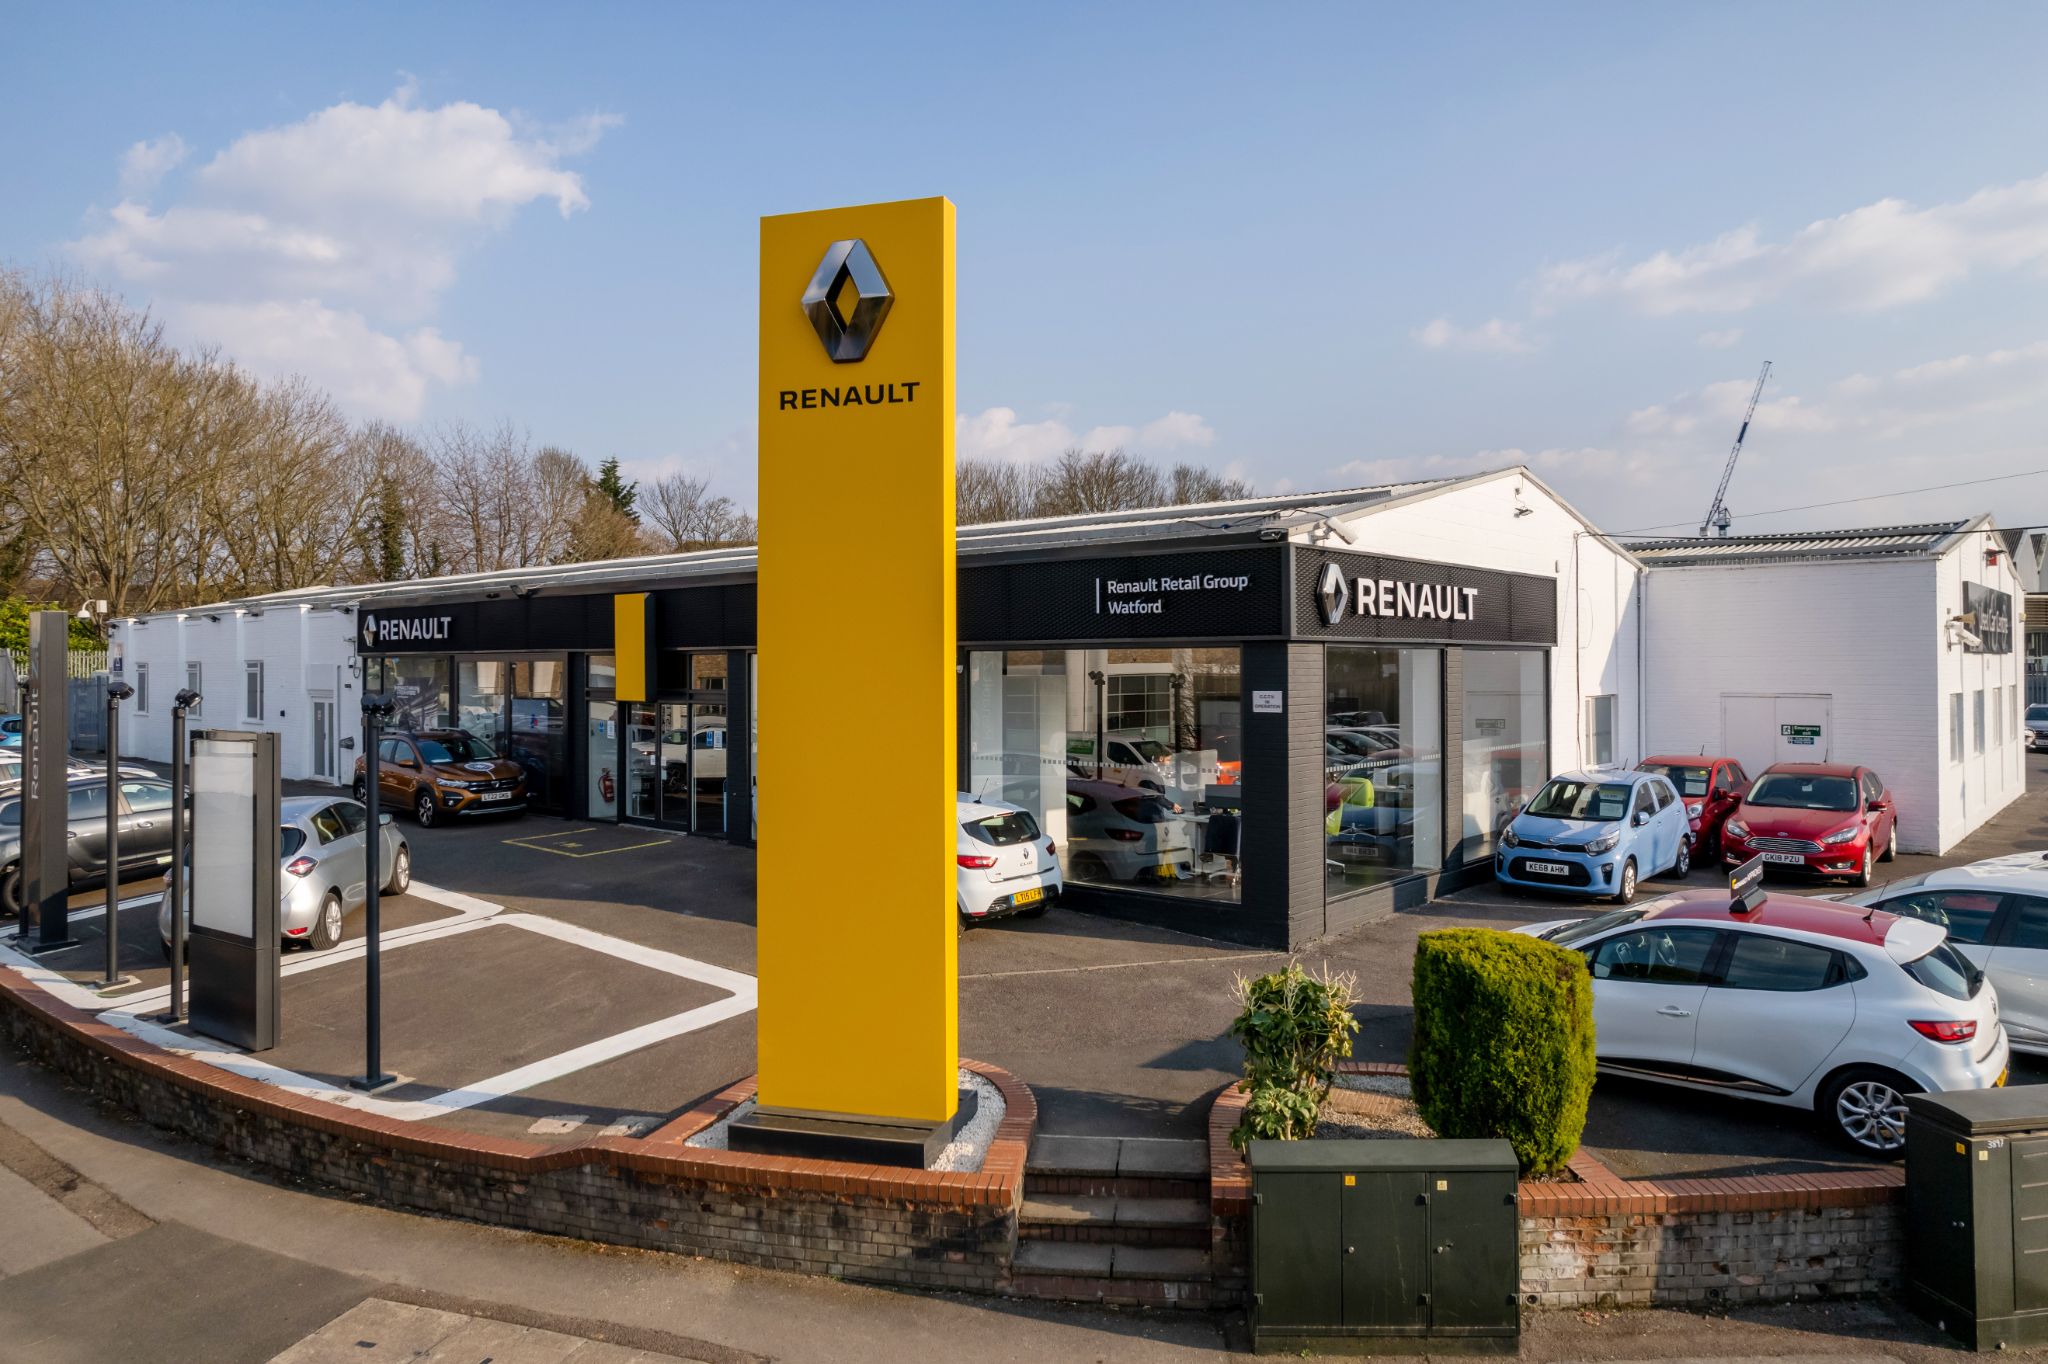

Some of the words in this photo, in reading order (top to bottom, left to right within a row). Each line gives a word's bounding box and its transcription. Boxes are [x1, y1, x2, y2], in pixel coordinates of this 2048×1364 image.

[780, 382, 920, 410] RENAULT
[1107, 577, 1158, 594] Renault
[1161, 575, 1200, 591] Retail
[1203, 574, 1249, 591] Group
[1108, 599, 1162, 614] Watford
[1357, 577, 1478, 620] RENAULT
[379, 616, 452, 641] RENAULT
[31, 688, 40, 800] Renault
[1550, 865, 1565, 873] AHK
[1764, 853, 1784, 862] GK18
[1784, 855, 1800, 863] PZU
